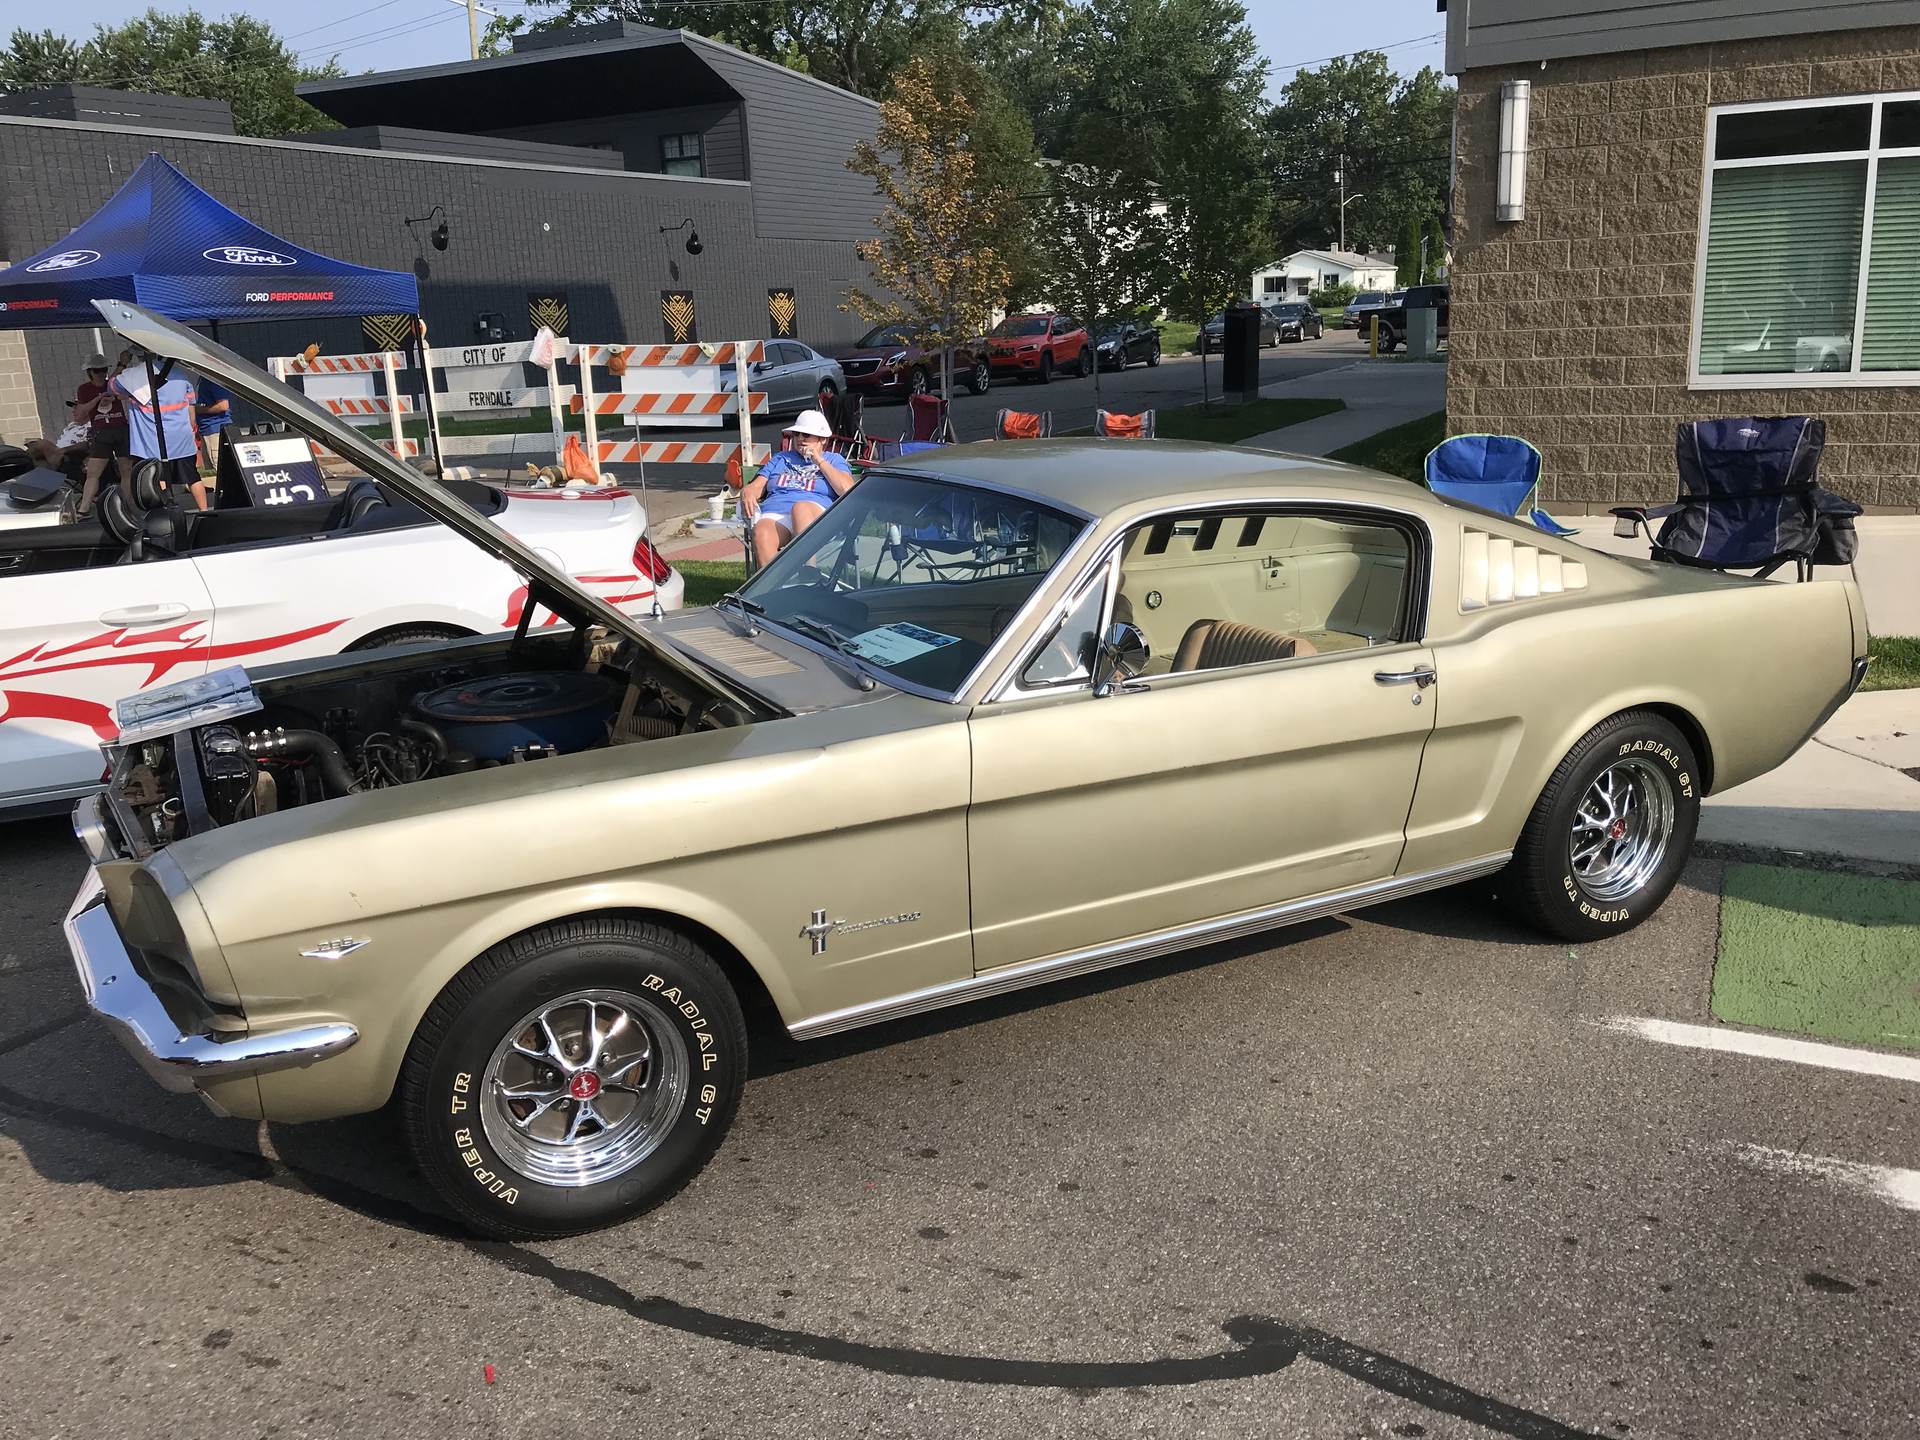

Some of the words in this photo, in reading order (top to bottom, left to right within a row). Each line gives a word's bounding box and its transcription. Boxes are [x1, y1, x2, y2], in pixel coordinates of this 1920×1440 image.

[246, 293, 270, 302] FORD
[270, 291, 334, 301] PERFORMANCE
[463, 348, 487, 365] CITY
[491, 346, 506, 363] OF
[468, 390, 513, 407] FERNDALE
[253, 469, 292, 486] Block
[1619, 740, 1680, 770] RADIAL
[1678, 772, 1693, 798] GT
[1563, 875, 1578, 902] TR
[1580, 901, 1629, 922] VIPER
[641, 974, 718, 1071] RADIAL
[695, 1084, 717, 1125] GT
[451, 1072, 472, 1114] TR
[455, 1127, 519, 1205] VIPER
